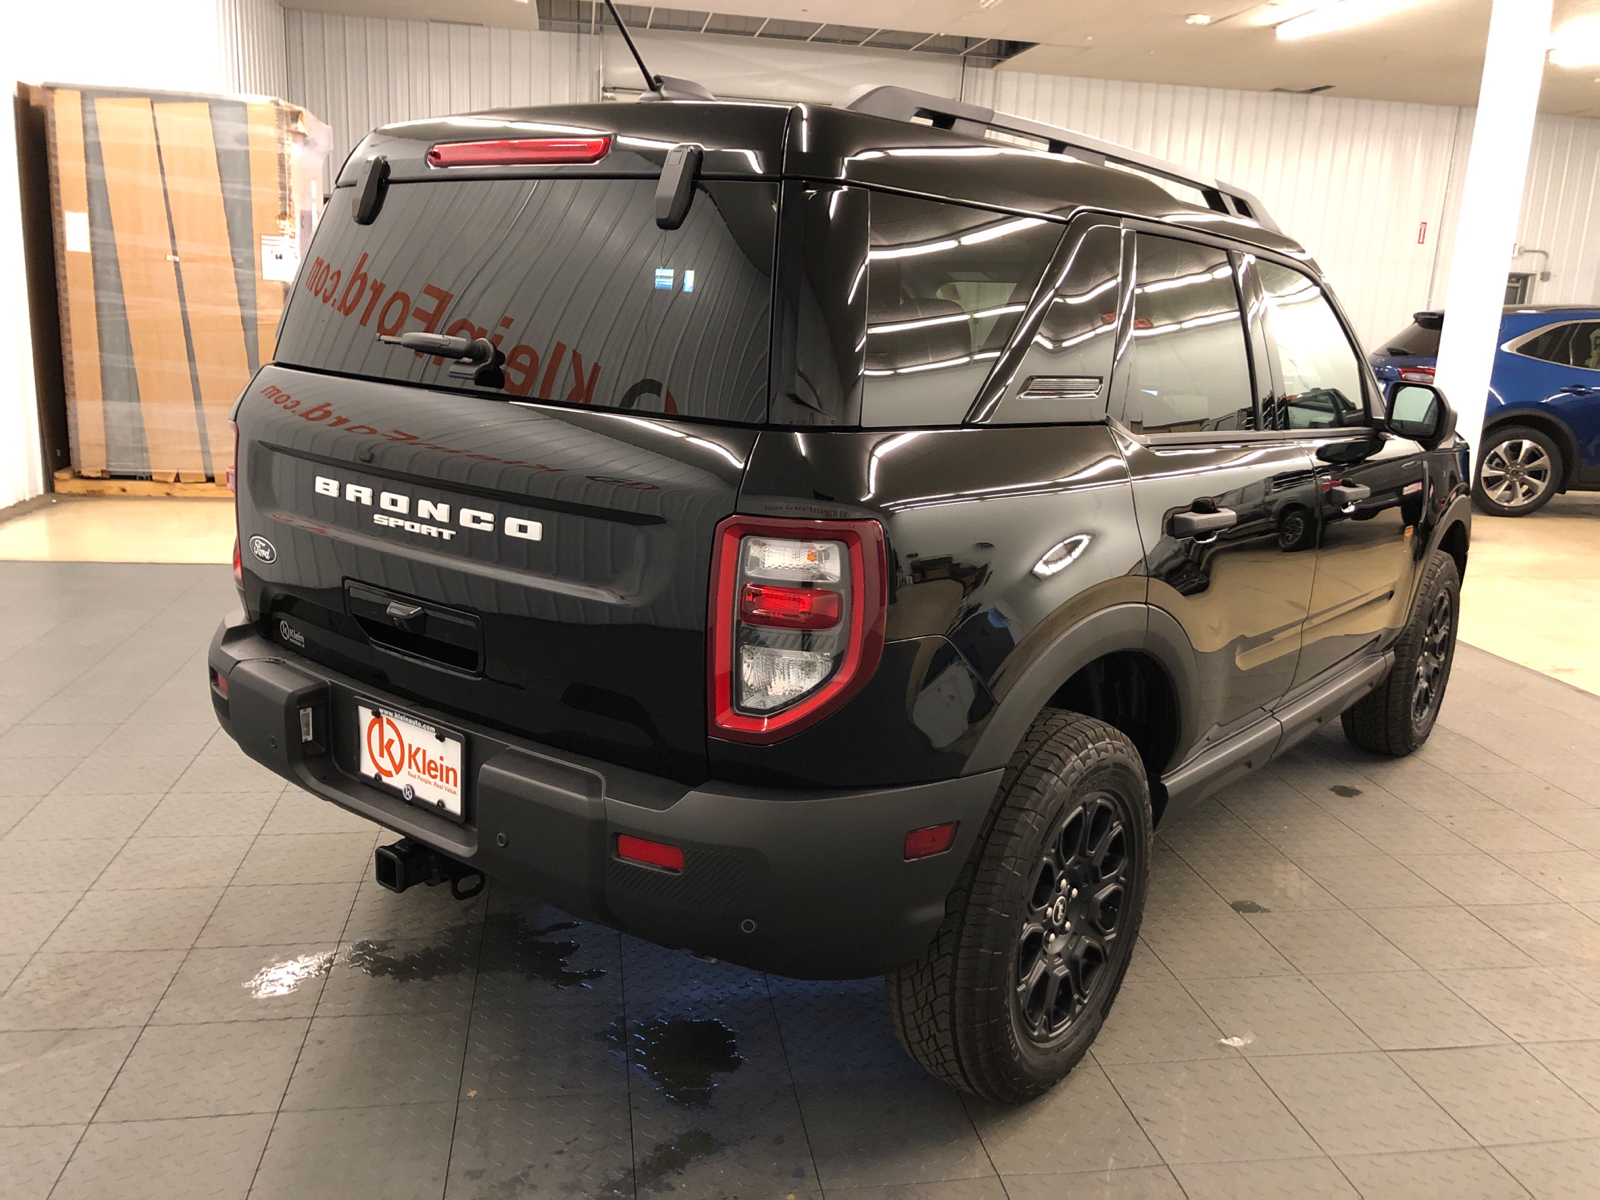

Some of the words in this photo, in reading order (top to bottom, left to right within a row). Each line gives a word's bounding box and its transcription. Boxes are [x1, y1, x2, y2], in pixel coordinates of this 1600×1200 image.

[315, 475, 543, 541] BRONCO
[373, 513, 456, 540] SPORT
[253, 539, 271, 560] Ford
[379, 708, 436, 733] www.kleinauto.com
[408, 743, 458, 788] Klein
[408, 770, 417, 779] Real
[433, 781, 444, 790] Real
